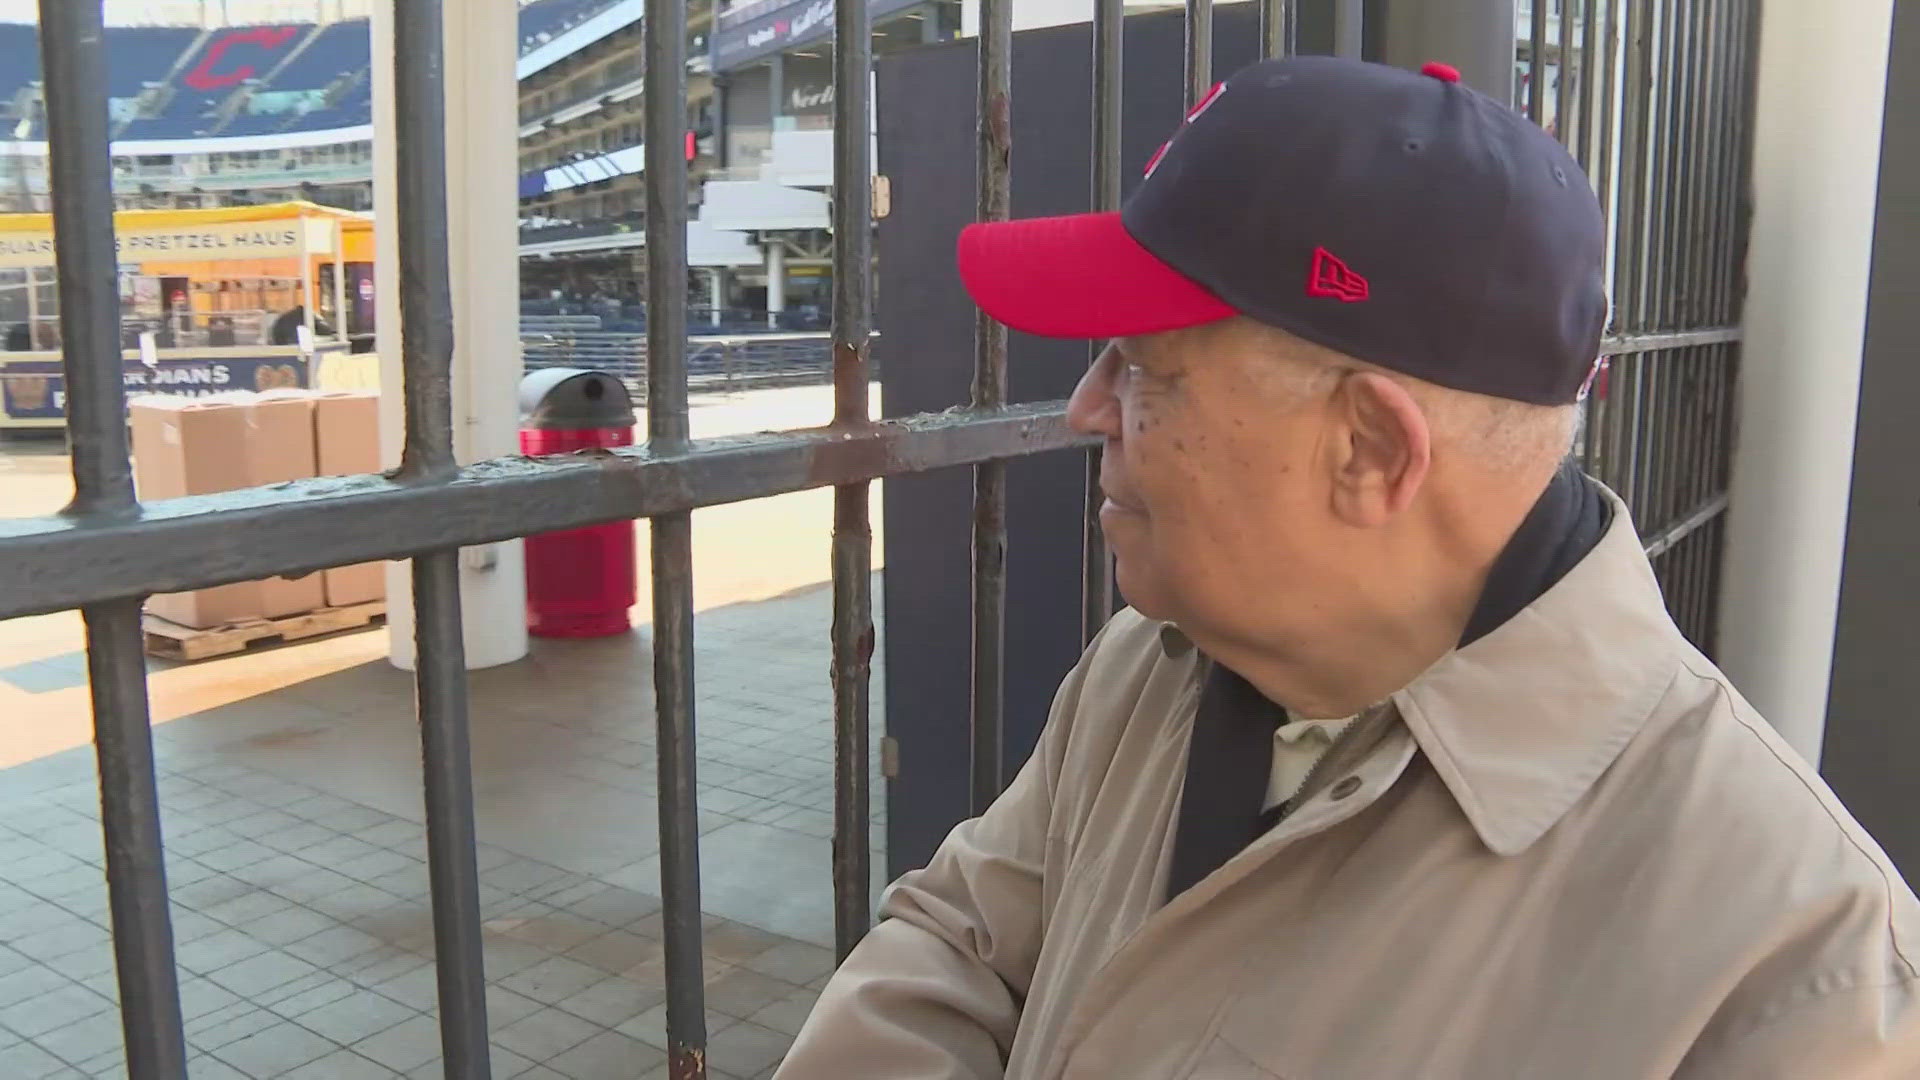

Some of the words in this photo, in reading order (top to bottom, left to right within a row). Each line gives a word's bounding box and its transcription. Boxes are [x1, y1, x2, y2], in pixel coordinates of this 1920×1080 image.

[184, 26, 297, 90] C
[129, 233, 227, 250] PRETZEL
[233, 230, 297, 247] HAUS
